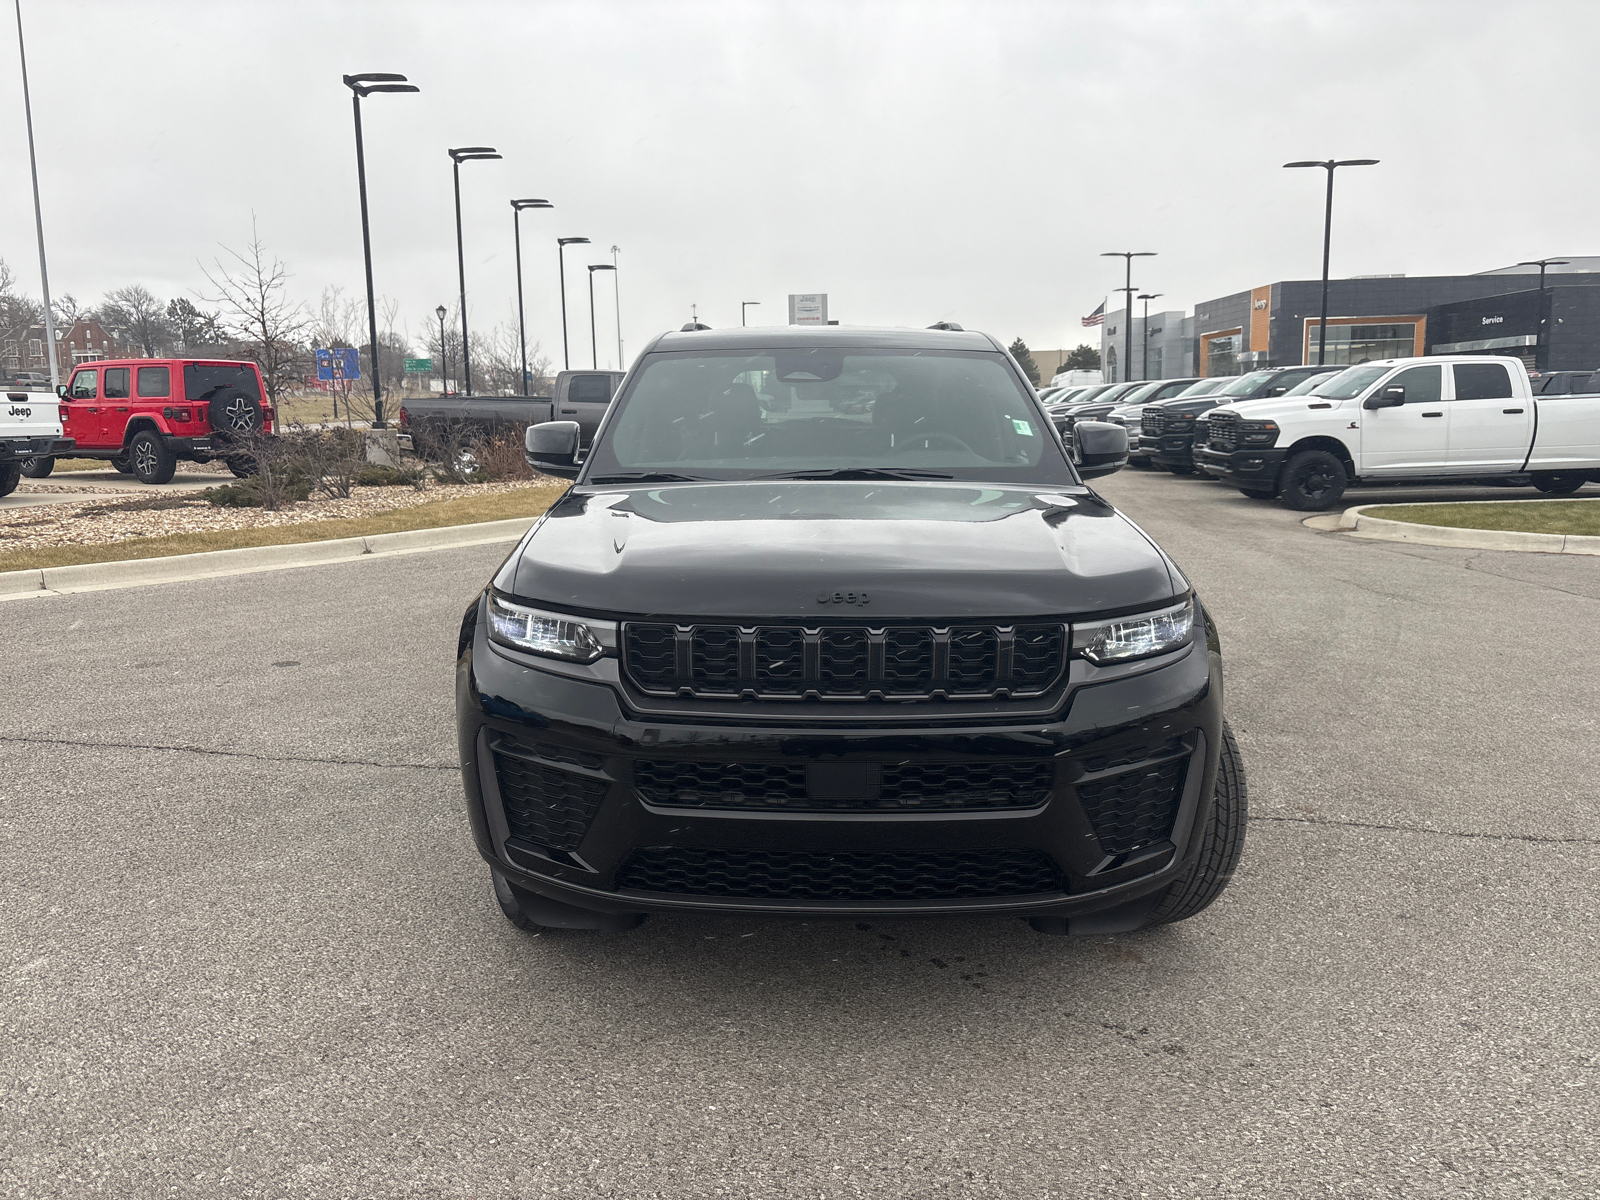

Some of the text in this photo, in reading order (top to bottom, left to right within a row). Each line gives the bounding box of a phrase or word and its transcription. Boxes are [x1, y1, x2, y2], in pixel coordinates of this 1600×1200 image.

[1481, 315, 1504, 325] Service
[8, 405, 32, 418] Jeep
[816, 589, 871, 607] Jeep
